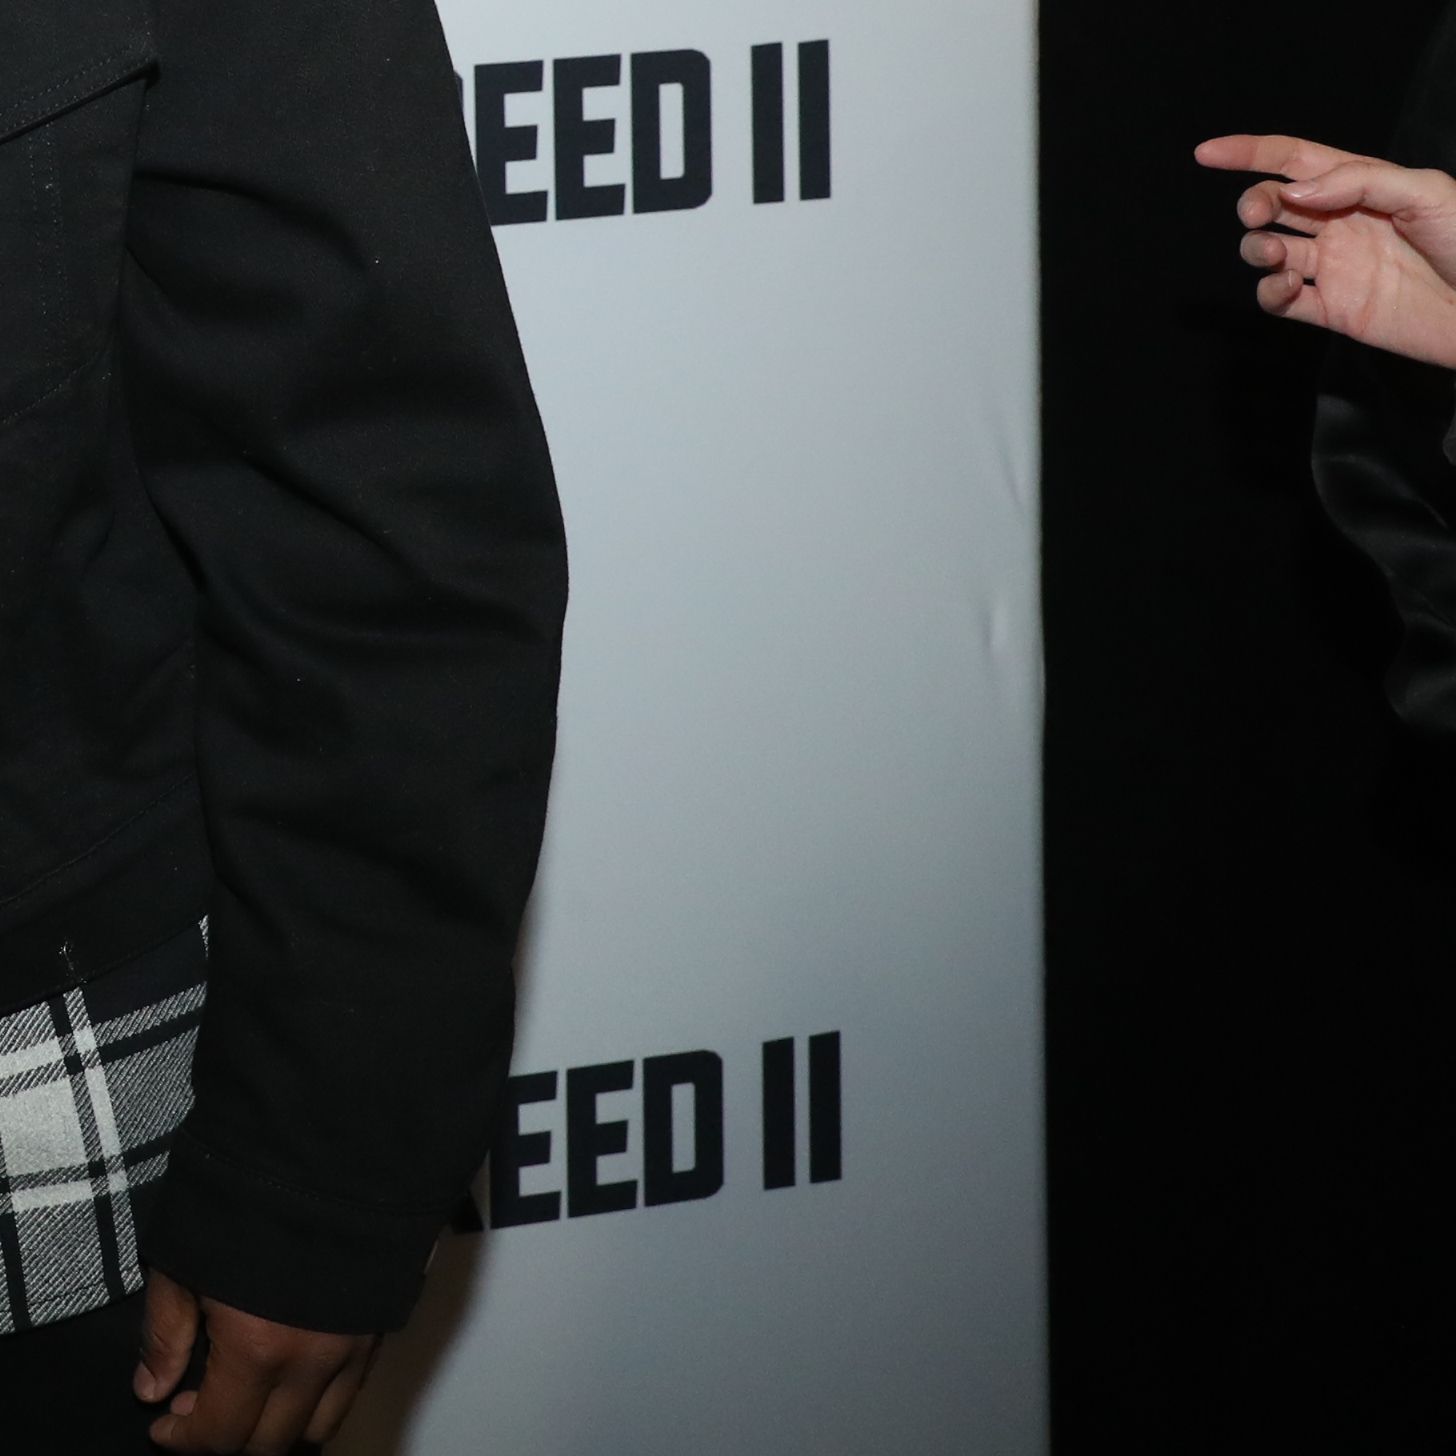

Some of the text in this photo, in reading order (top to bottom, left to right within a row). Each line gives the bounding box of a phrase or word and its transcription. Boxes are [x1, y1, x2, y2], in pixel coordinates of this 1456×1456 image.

[474, 39, 831, 227] EED II
[488, 1030, 843, 1230] EED II
